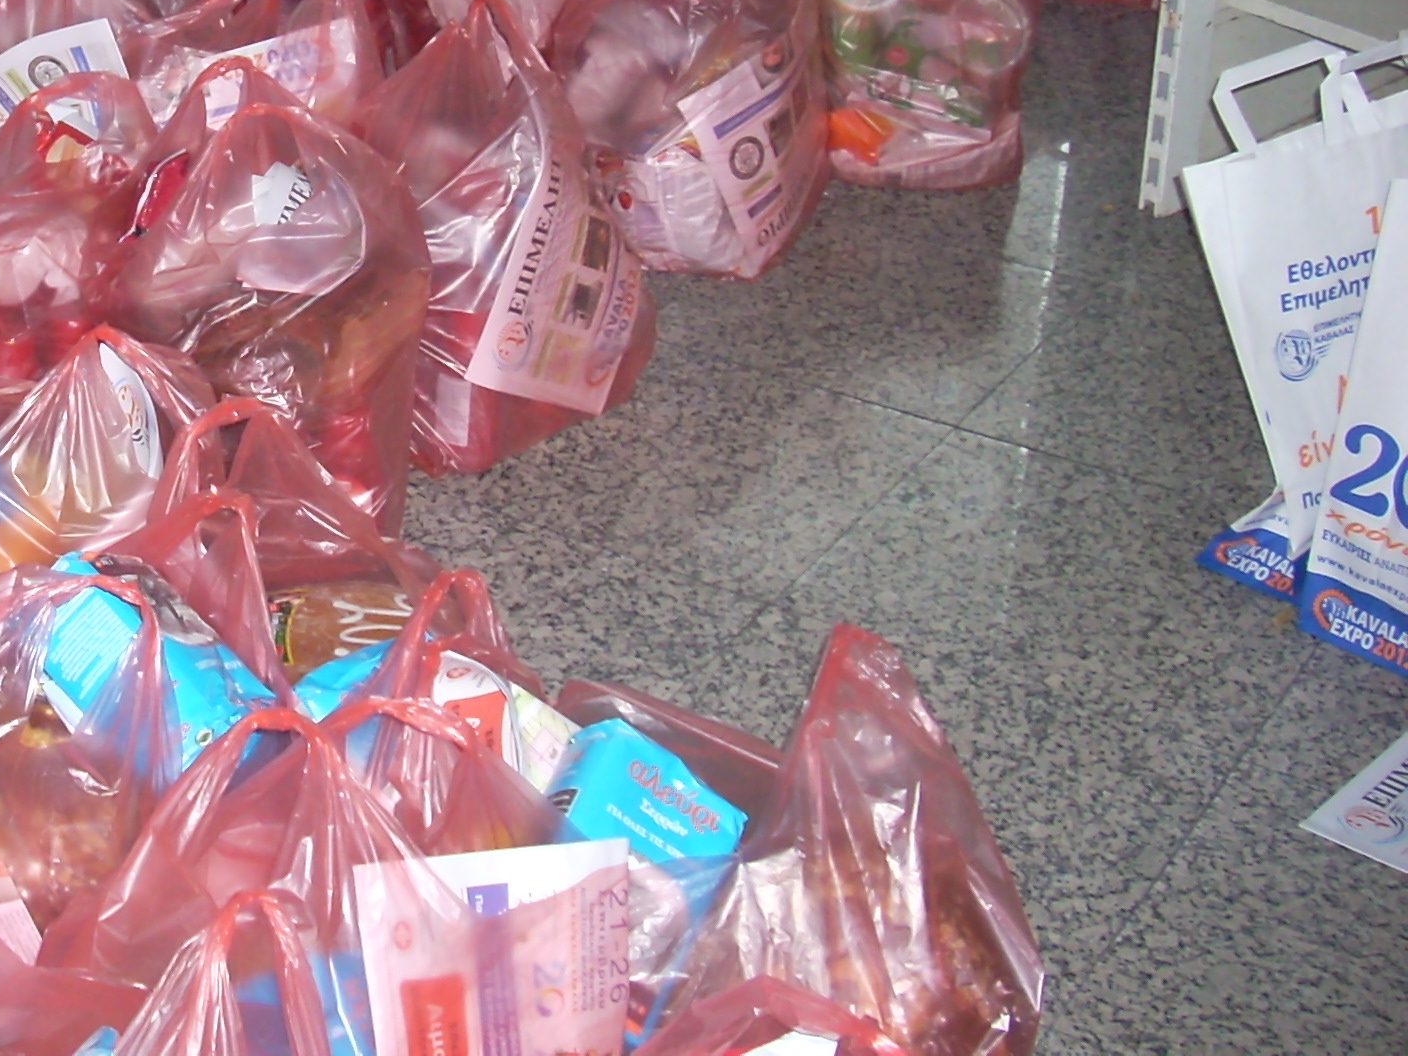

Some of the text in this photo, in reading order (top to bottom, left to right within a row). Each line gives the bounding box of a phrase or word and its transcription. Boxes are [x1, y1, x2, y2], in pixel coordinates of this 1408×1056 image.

[1329, 424, 1408, 530] 2
[1325, 508, 1408, 556] χρόν
[1227, 554, 1270, 582] EXPO
[1329, 618, 1375, 651] EXPO
